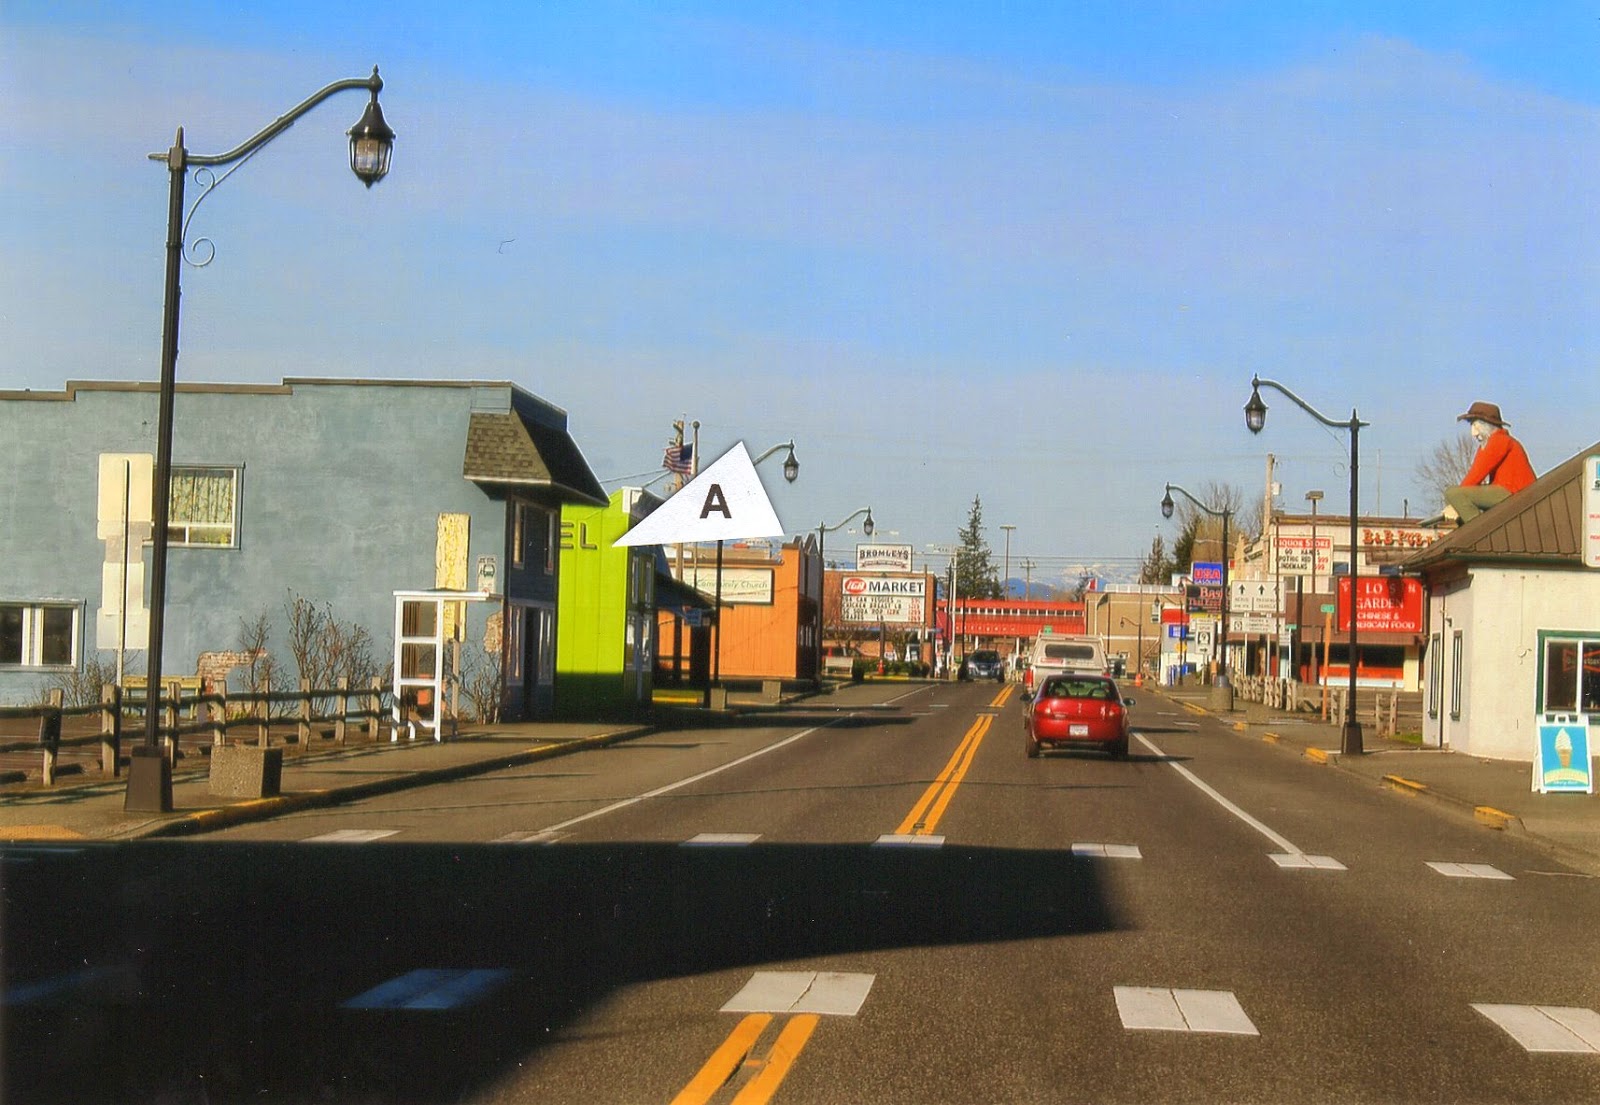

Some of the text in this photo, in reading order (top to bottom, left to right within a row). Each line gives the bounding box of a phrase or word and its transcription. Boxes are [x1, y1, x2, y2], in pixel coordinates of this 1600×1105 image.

[1194, 568, 1220, 580] USA
[741, 580, 768, 589] Church
[846, 580, 924, 593] IGA MARKET
[1357, 597, 1404, 609] GARDEN
[1357, 612, 1399, 620] CHINESE &
[1390, 621, 1415, 629] FOOD
